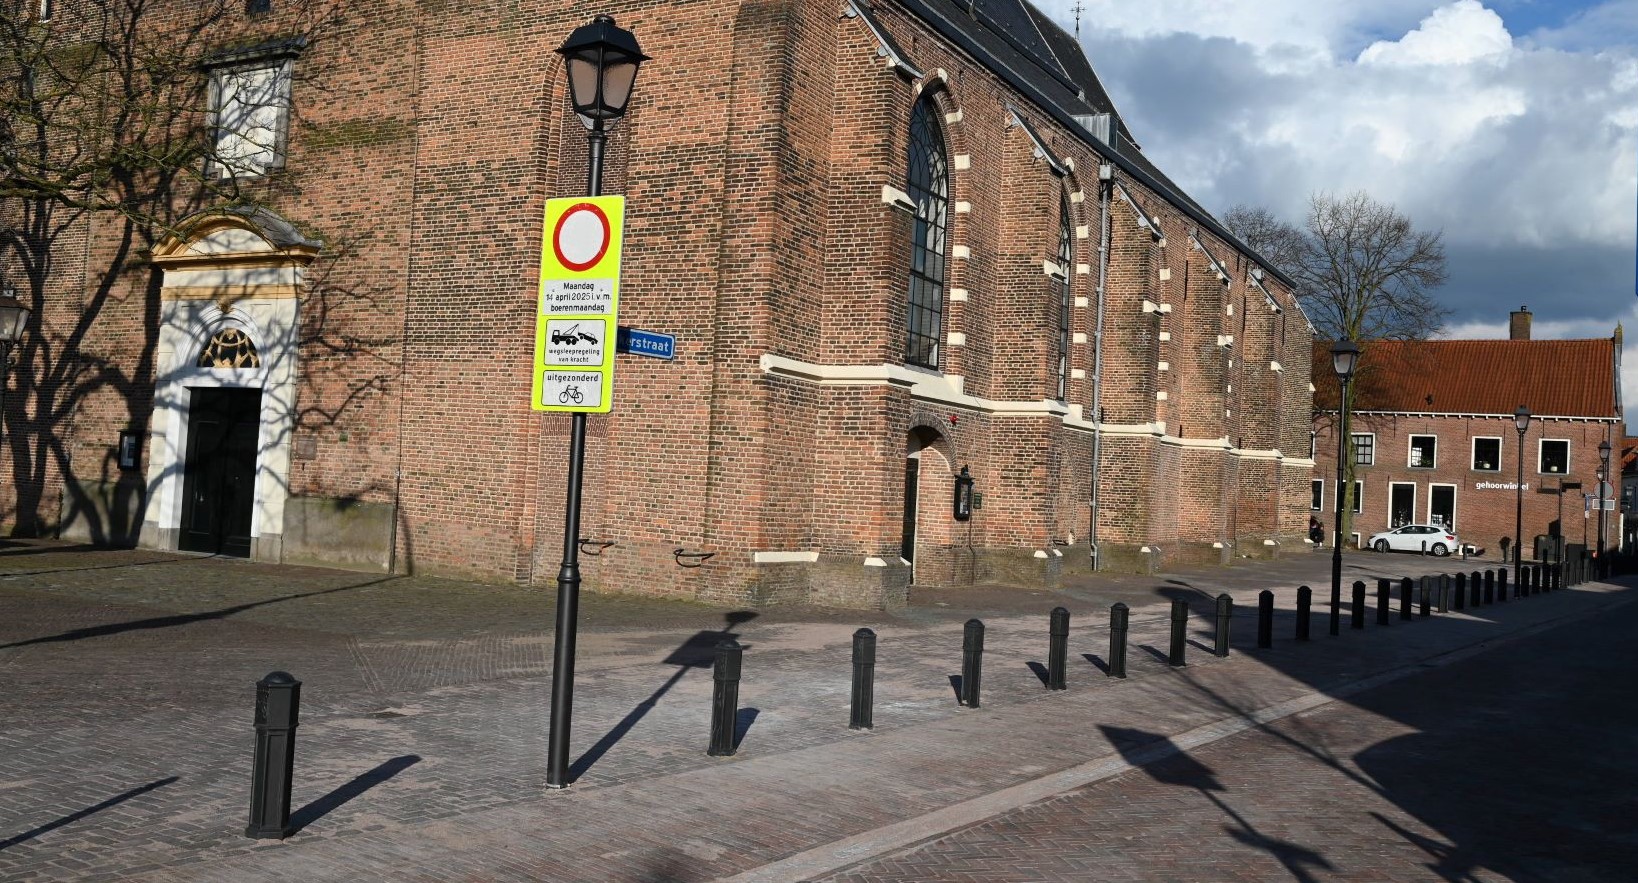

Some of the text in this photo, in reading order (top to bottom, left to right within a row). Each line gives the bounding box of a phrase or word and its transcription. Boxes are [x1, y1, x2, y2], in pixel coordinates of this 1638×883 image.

[563, 282, 594, 291] Maandag
[555, 294, 571, 302] april
[571, 292, 591, 301] 2025
[550, 304, 604, 313] boerenmaandag
[548, 348, 600, 356] wegsleepregeling
[547, 374, 599, 383] uitgezonderd
[1476, 481, 1528, 490] gehoorwinel
